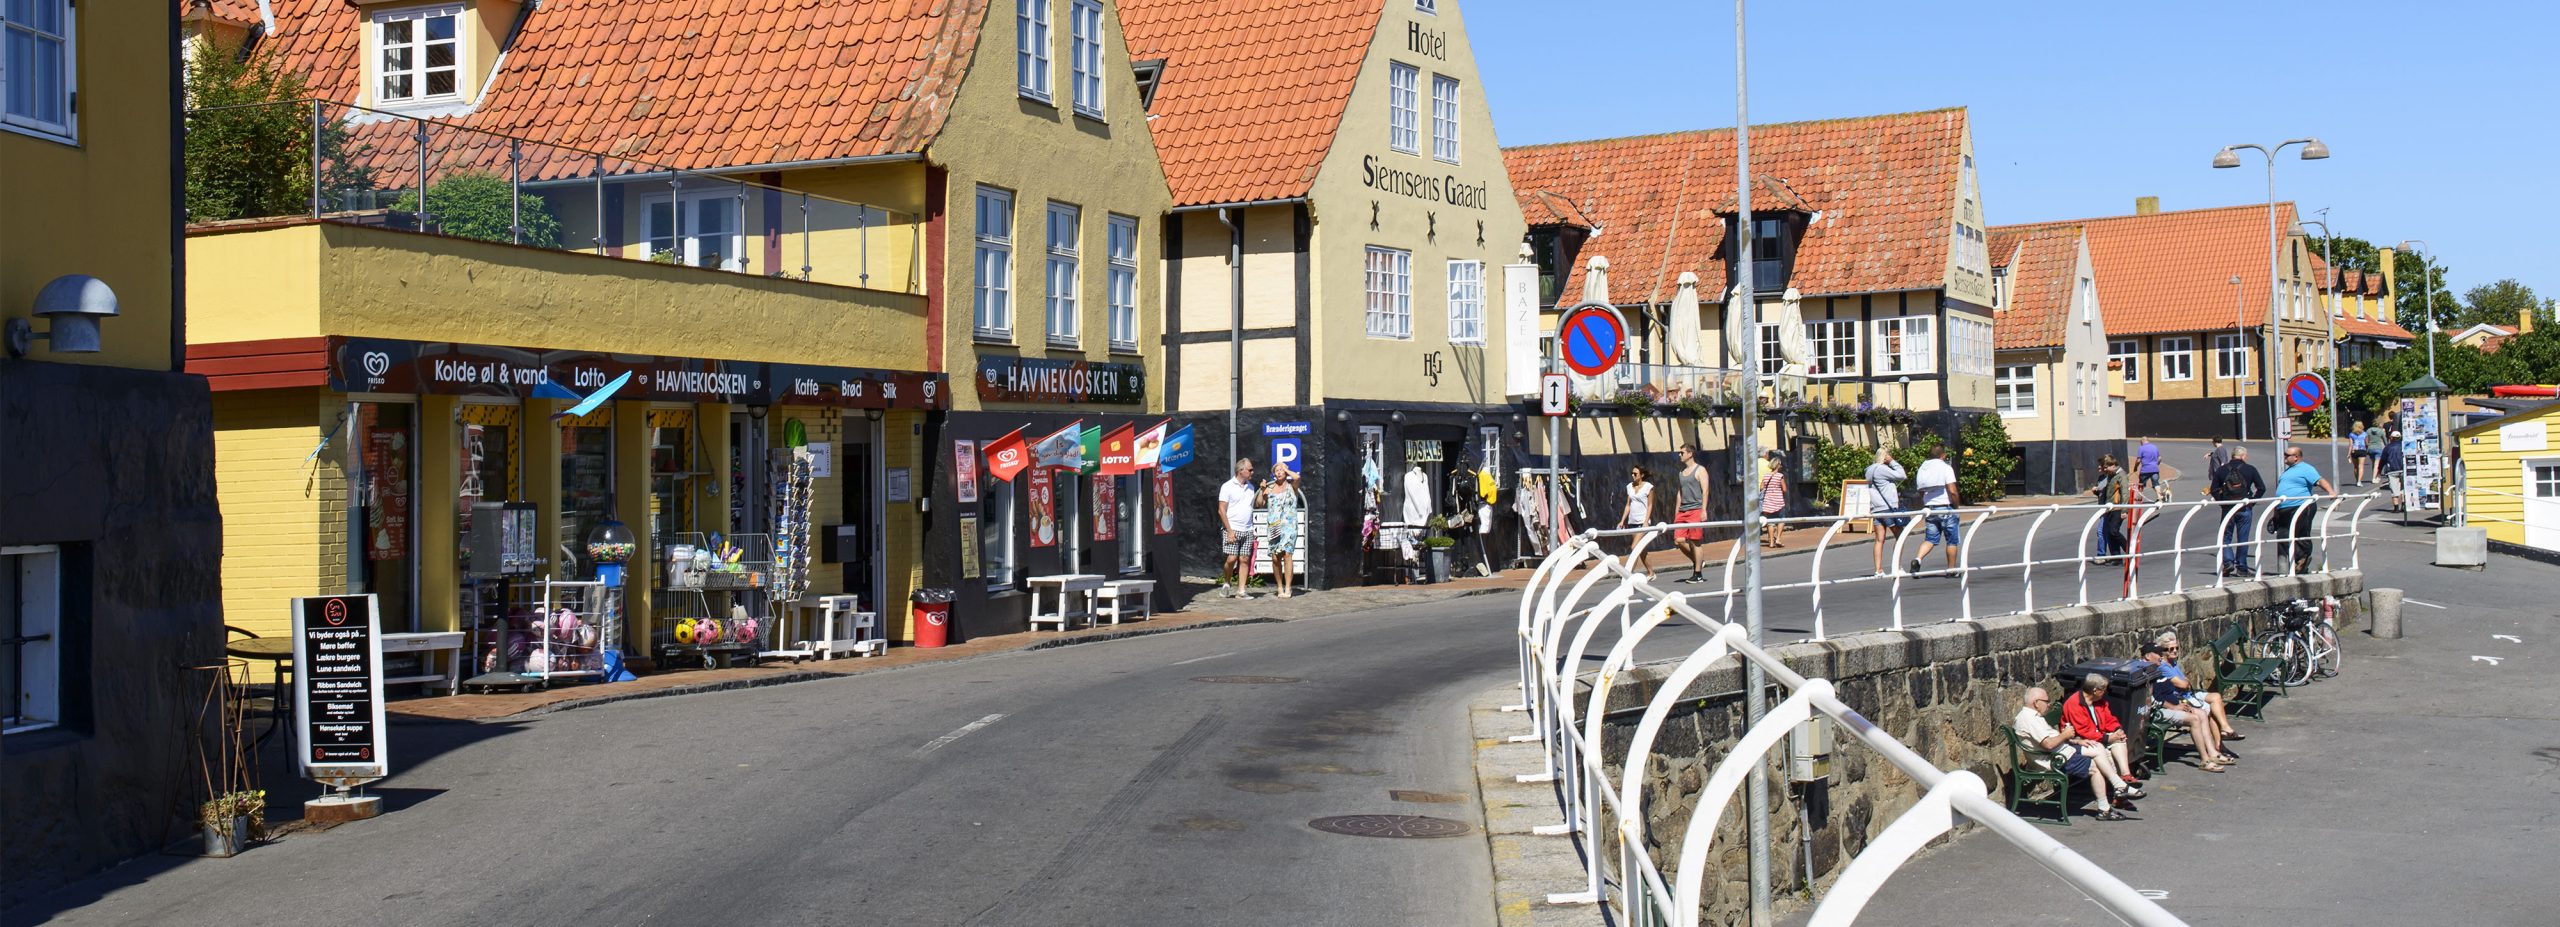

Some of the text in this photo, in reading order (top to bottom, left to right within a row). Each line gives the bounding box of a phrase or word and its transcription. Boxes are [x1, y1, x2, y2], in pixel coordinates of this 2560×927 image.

[1408, 20, 1446, 61] Hotel
[1363, 154, 1487, 211] Siemsens Gaard
[435, 359, 548, 386] Kolde øl & vand
[574, 367, 606, 388] Lotto
[655, 370, 747, 395] HAVNEKIOSKEN
[1007, 366, 1118, 395] HAVNEKIOSKEN
[795, 377, 898, 400] Kaffe Brød Slik
[1102, 455, 1130, 464] LOTTO
[1276, 443, 1298, 464] P
[1405, 440, 1442, 460] UDSALG
[308, 631, 316, 639] Vi
[316, 630, 334, 640] byder
[335, 630, 350, 640] også
[320, 641, 356, 650] Møre bøffer
[316, 653, 361, 662] Lækre burgere
[316, 664, 361, 673] Lune sandwich
[347, 725, 363, 733] suppe
